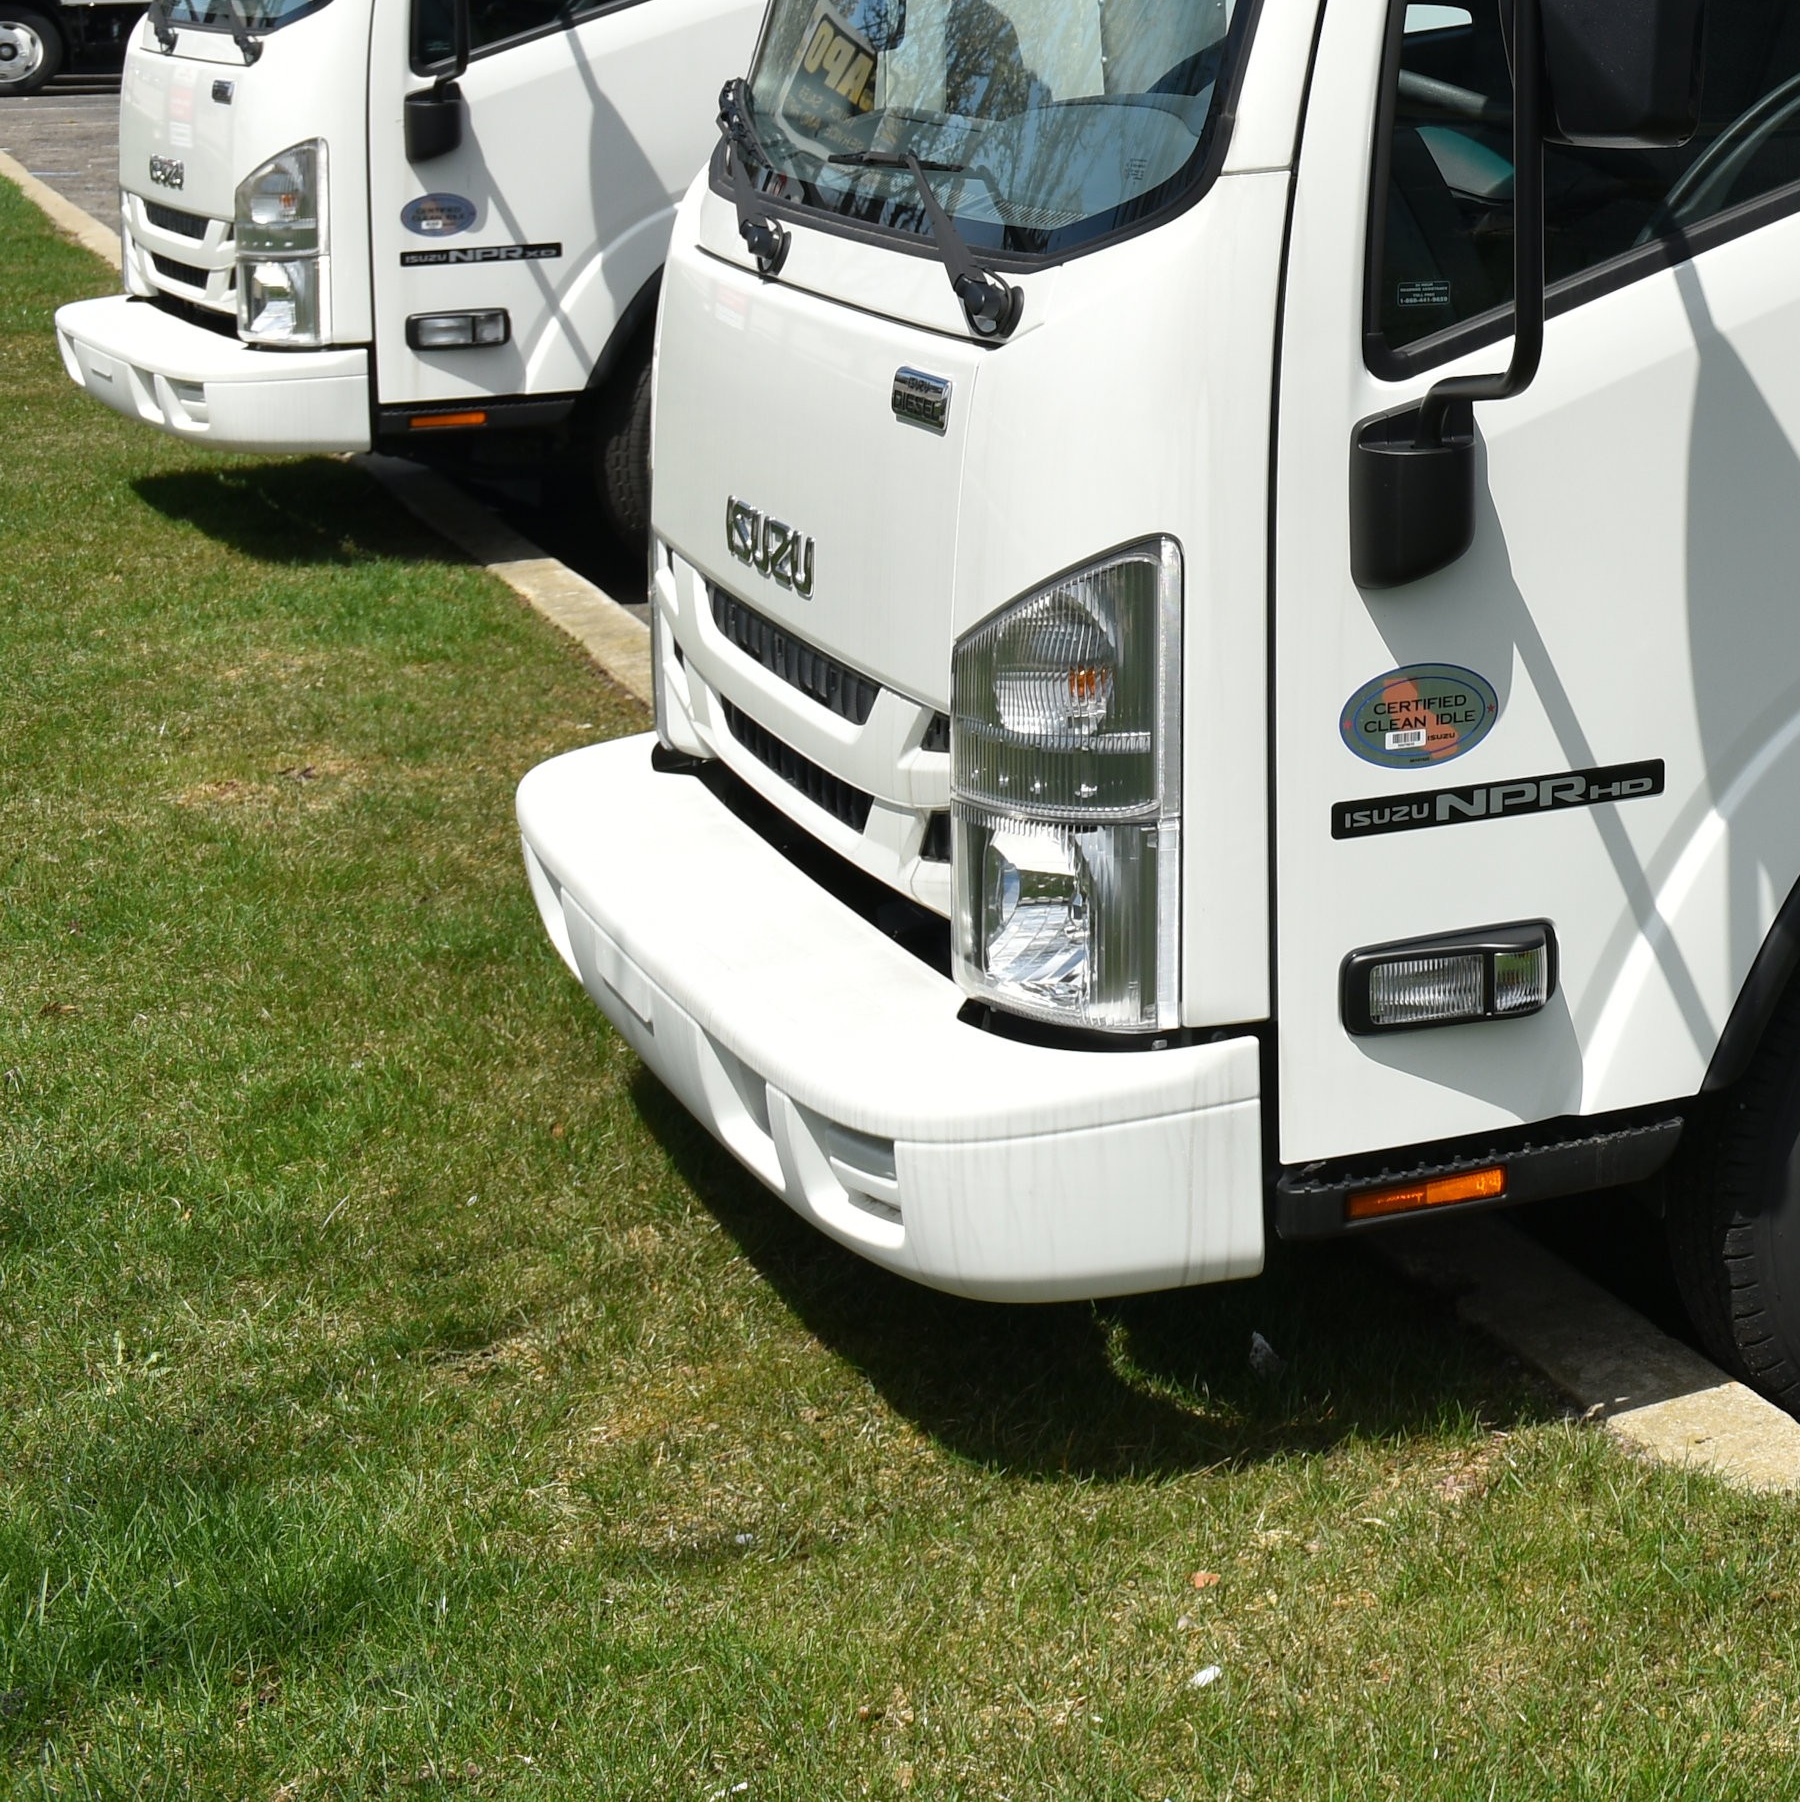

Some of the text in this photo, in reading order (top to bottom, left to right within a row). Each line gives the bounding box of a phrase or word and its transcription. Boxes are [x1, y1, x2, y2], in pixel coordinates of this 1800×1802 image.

[405, 254, 447, 264] ISUZU
[449, 246, 523, 263] NPR
[891, 389, 940, 422] DIESEL
[726, 495, 816, 601] ISUZU
[1373, 694, 1467, 715] CERTIFIED
[1364, 709, 1476, 733] CLEAN IDLE
[1427, 732, 1456, 742] ISUZU
[1345, 775, 1654, 829] ISUZU NPR HD
